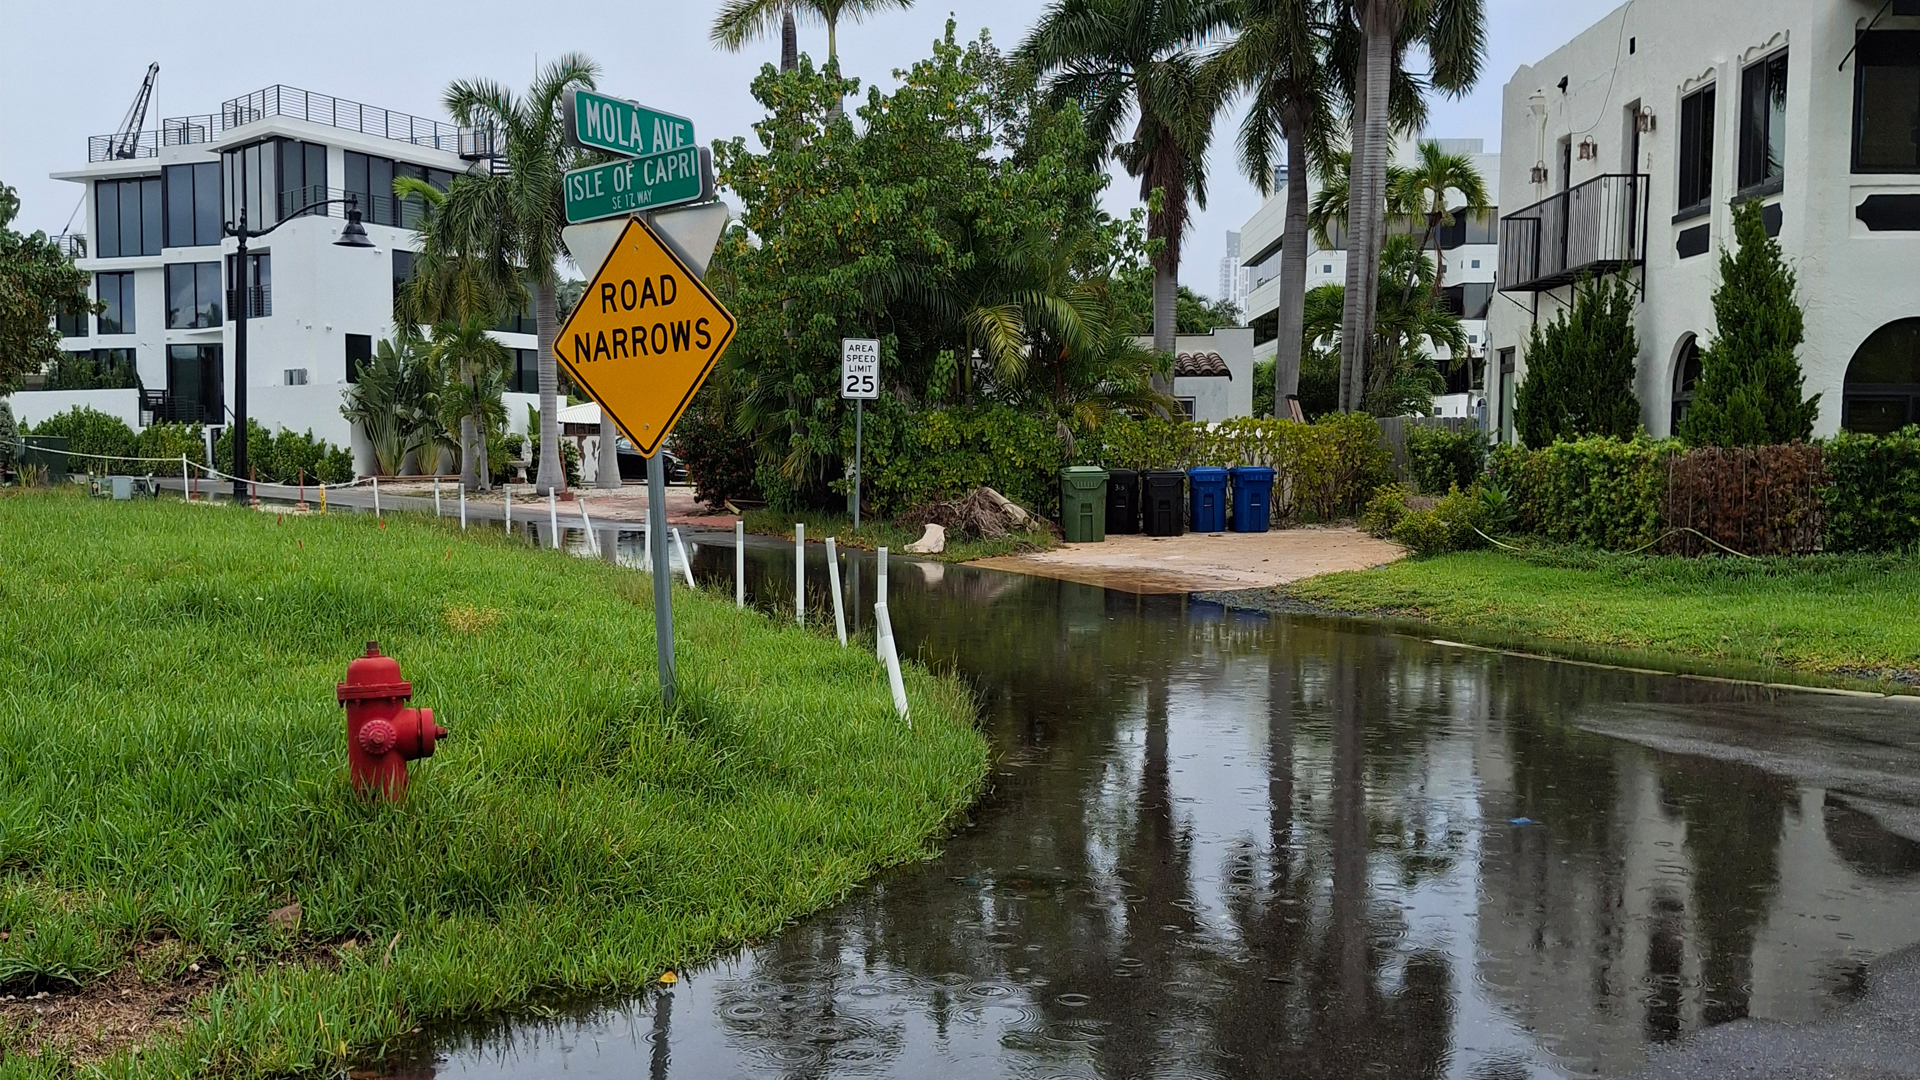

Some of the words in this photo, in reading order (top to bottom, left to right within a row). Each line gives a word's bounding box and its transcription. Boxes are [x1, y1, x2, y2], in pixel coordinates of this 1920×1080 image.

[585, 98, 643, 150] MOLA
[652, 117, 685, 153] AVE
[567, 170, 605, 203] ISLE
[613, 161, 634, 193] OF
[643, 150, 696, 186] CAPRI
[611, 195, 623, 210] SE
[625, 192, 635, 208] 17
[636, 188, 653, 205] WAY
[601, 274, 677, 314] ROAD
[574, 317, 712, 364] NARROWS
[848, 344, 874, 353] AREA
[846, 354, 877, 363] SPEED
[848, 364, 873, 373] LIMIT
[846, 374, 875, 393] 25
